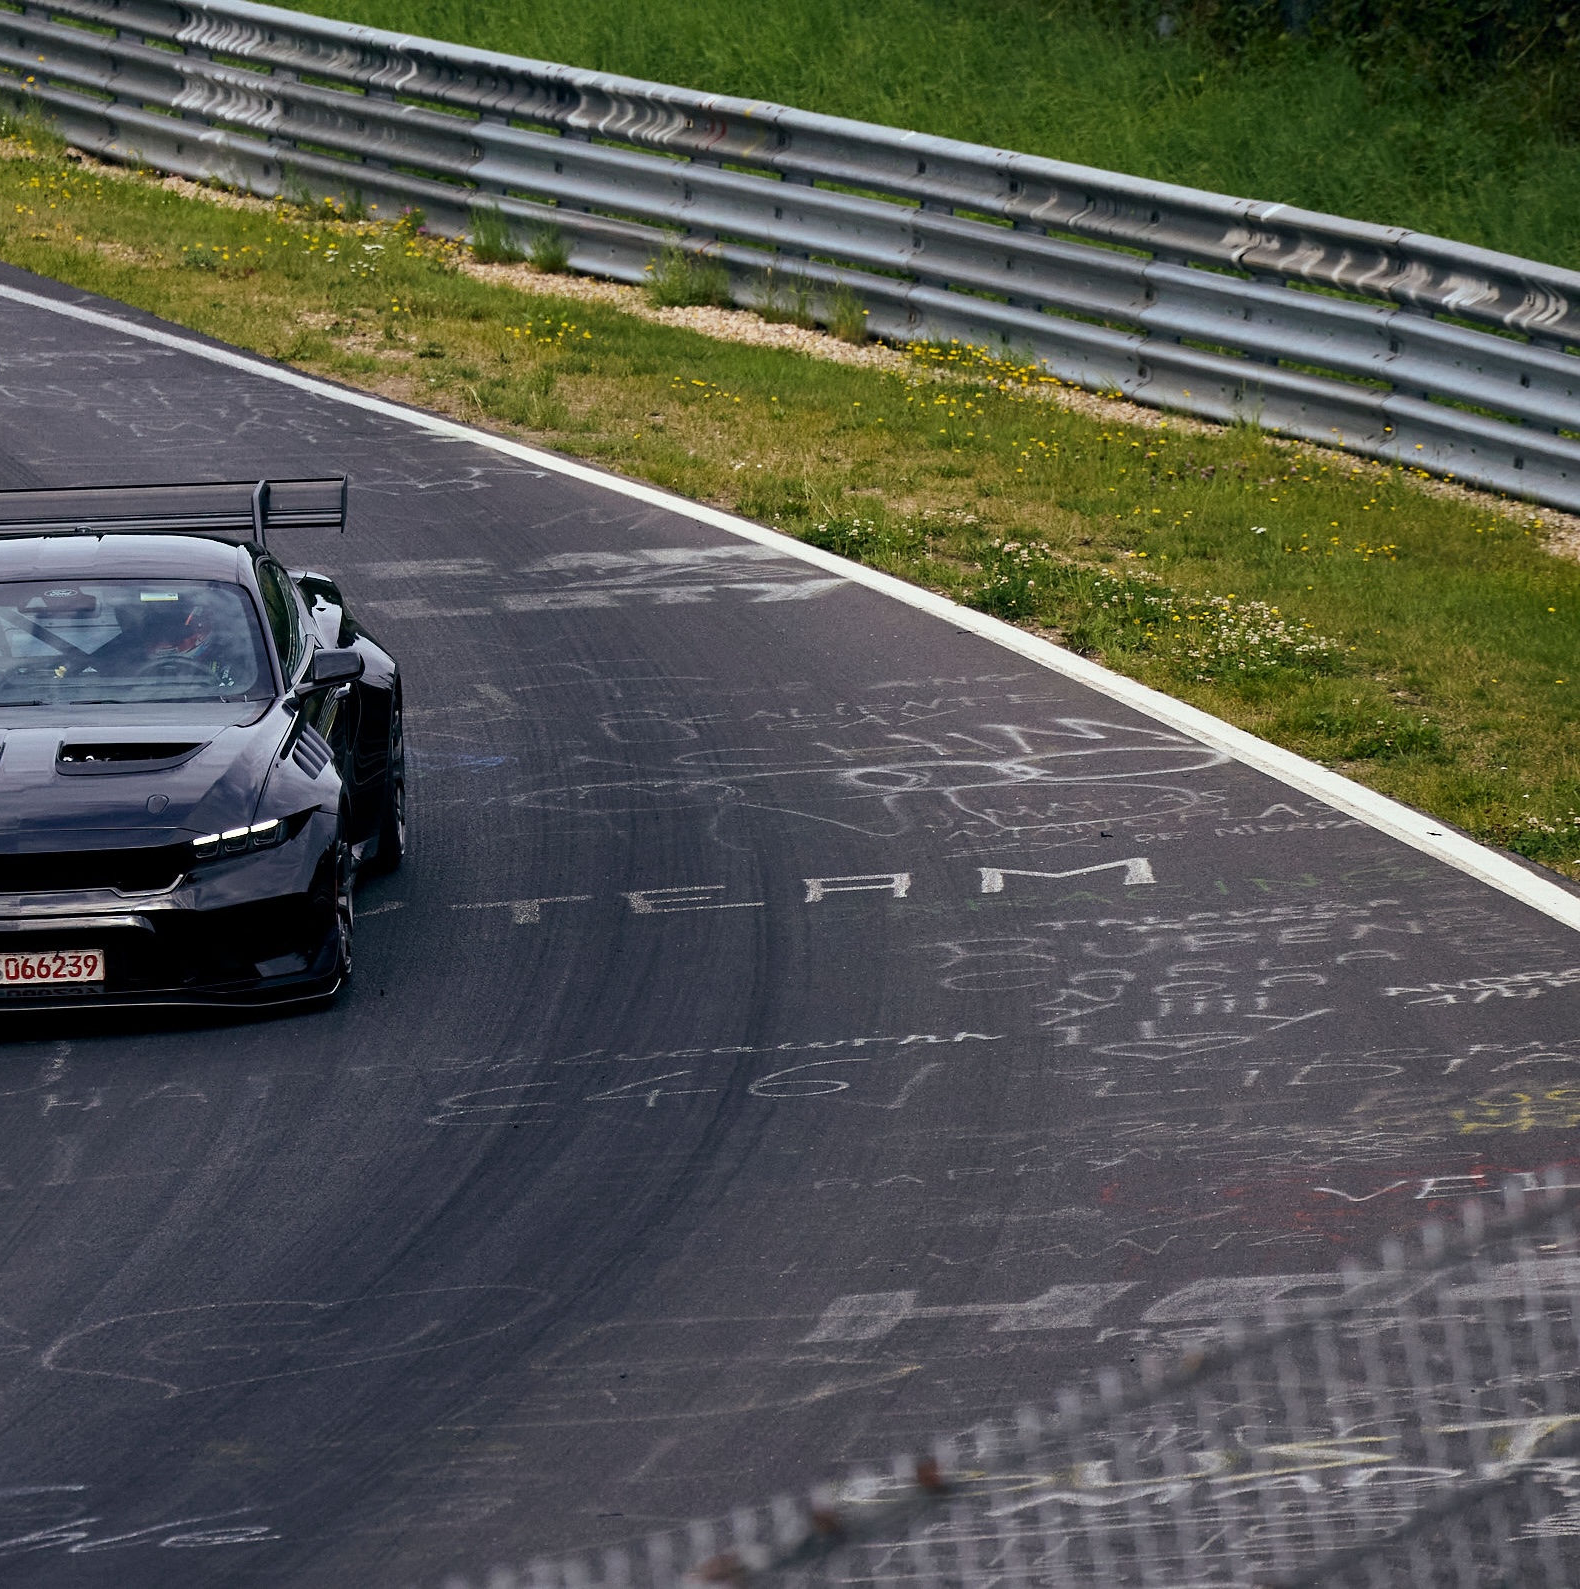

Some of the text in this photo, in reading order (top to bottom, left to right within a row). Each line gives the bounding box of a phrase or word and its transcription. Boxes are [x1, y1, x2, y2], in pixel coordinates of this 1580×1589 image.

[451, 856, 1157, 924] TEAM
[5, 955, 98, 980] 066239
[426, 1057, 872, 1126] E46
